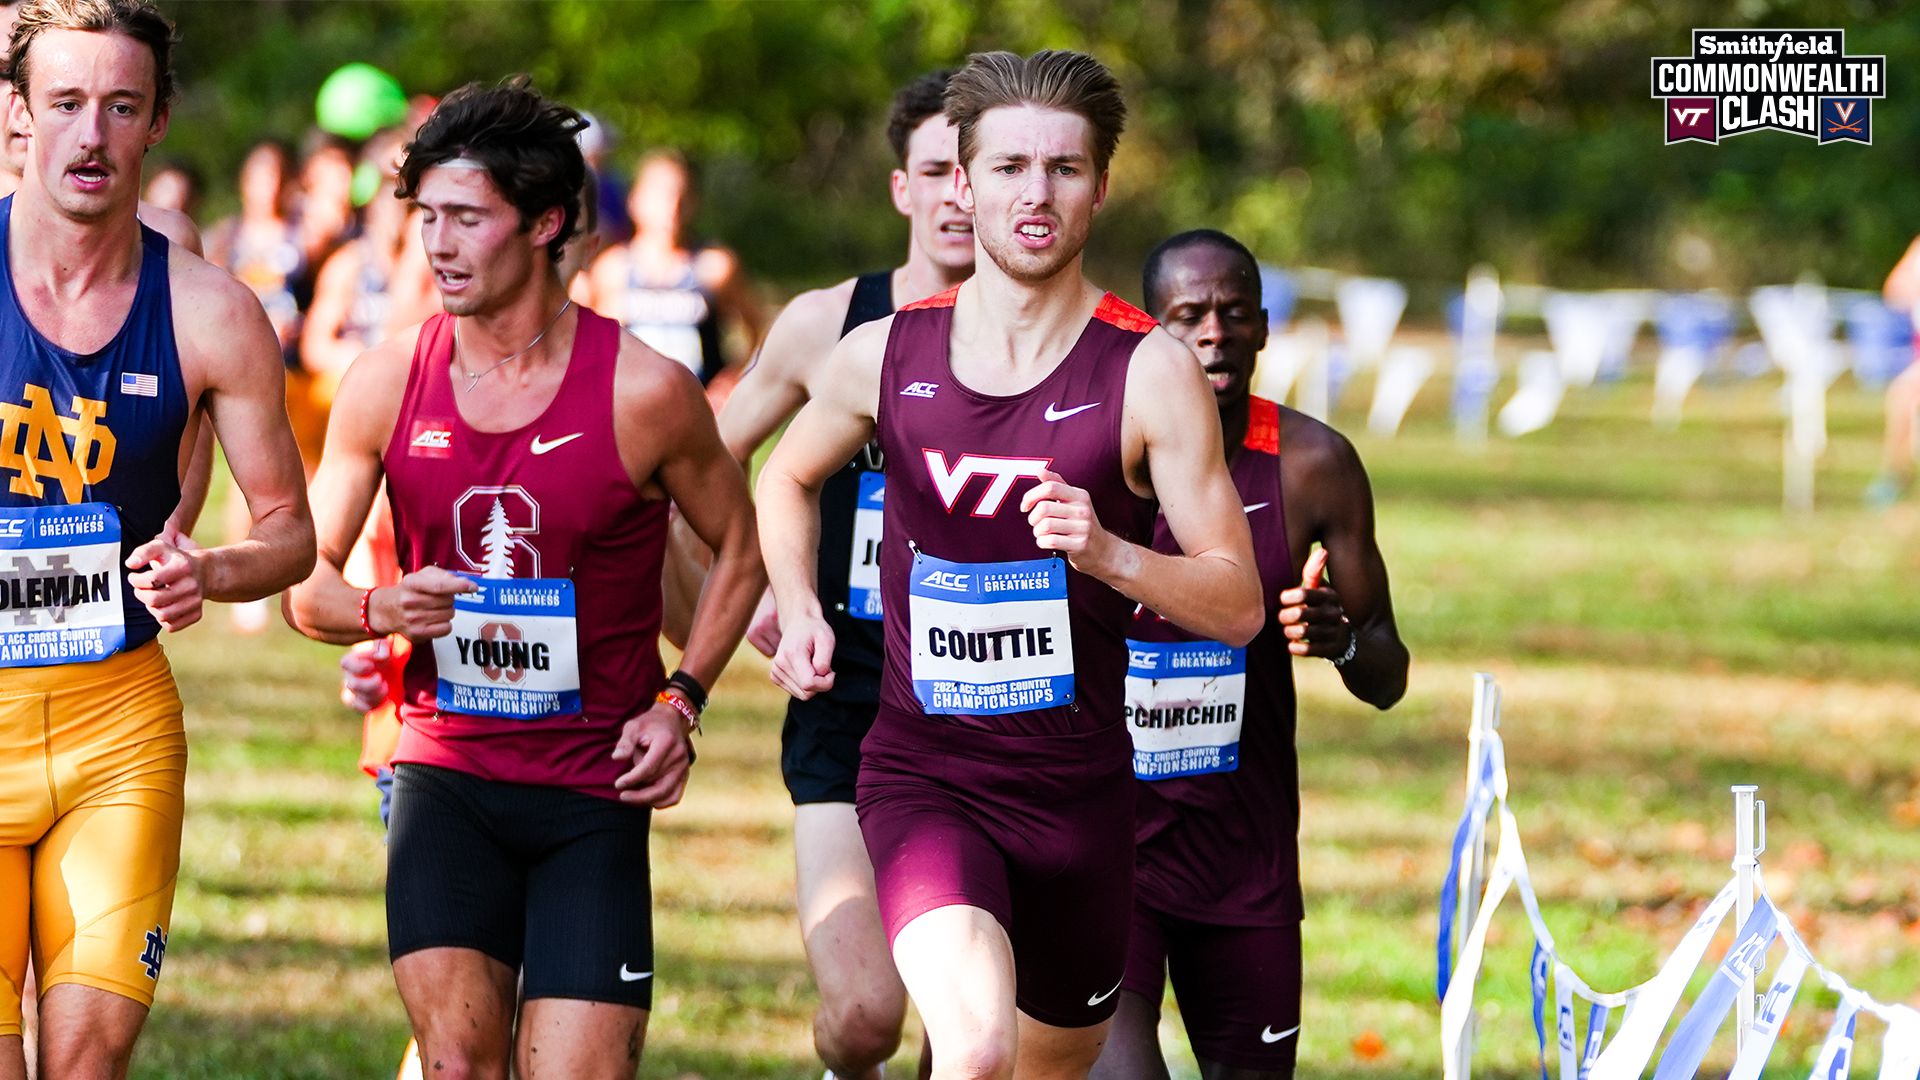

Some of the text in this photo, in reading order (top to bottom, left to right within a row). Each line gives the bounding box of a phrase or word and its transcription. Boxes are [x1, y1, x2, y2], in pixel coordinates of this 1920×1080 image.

[900, 382, 940, 398] ACC
[411, 430, 452, 448] ACC
[922, 448, 1054, 518] VT
[40, 514, 104, 525] ACCOMPLISH
[40, 521, 104, 536] GREATNESS
[862, 538, 882, 566] J
[920, 571, 971, 592] ACC
[984, 571, 1049, 581] ACCOMPLISH
[984, 578, 1050, 592] GREATNESS
[500, 594, 560, 607] GREATNESS
[8, 633, 26, 645] ACC
[28, 631, 58, 644] CROSS
[60, 628, 101, 642] COUNTRY
[928, 626, 1054, 663] COUTTIE
[1, 639, 104, 661] AMPIONSHIPS
[455, 635, 550, 671] YOUNG
[1129, 650, 1160, 669] CC
[475, 687, 491, 698] ACC
[493, 689, 519, 701] CROSS
[521, 691, 559, 702] COUNTRY
[933, 678, 1052, 696] 2025 ACC CROSS COUNTRY
[453, 694, 560, 715] CHAMPIONSHIPS
[933, 688, 1054, 709] CHAMPIONSHIPS
[1154, 750, 1181, 762] CROSS
[1183, 747, 1221, 758] COUNTRY
